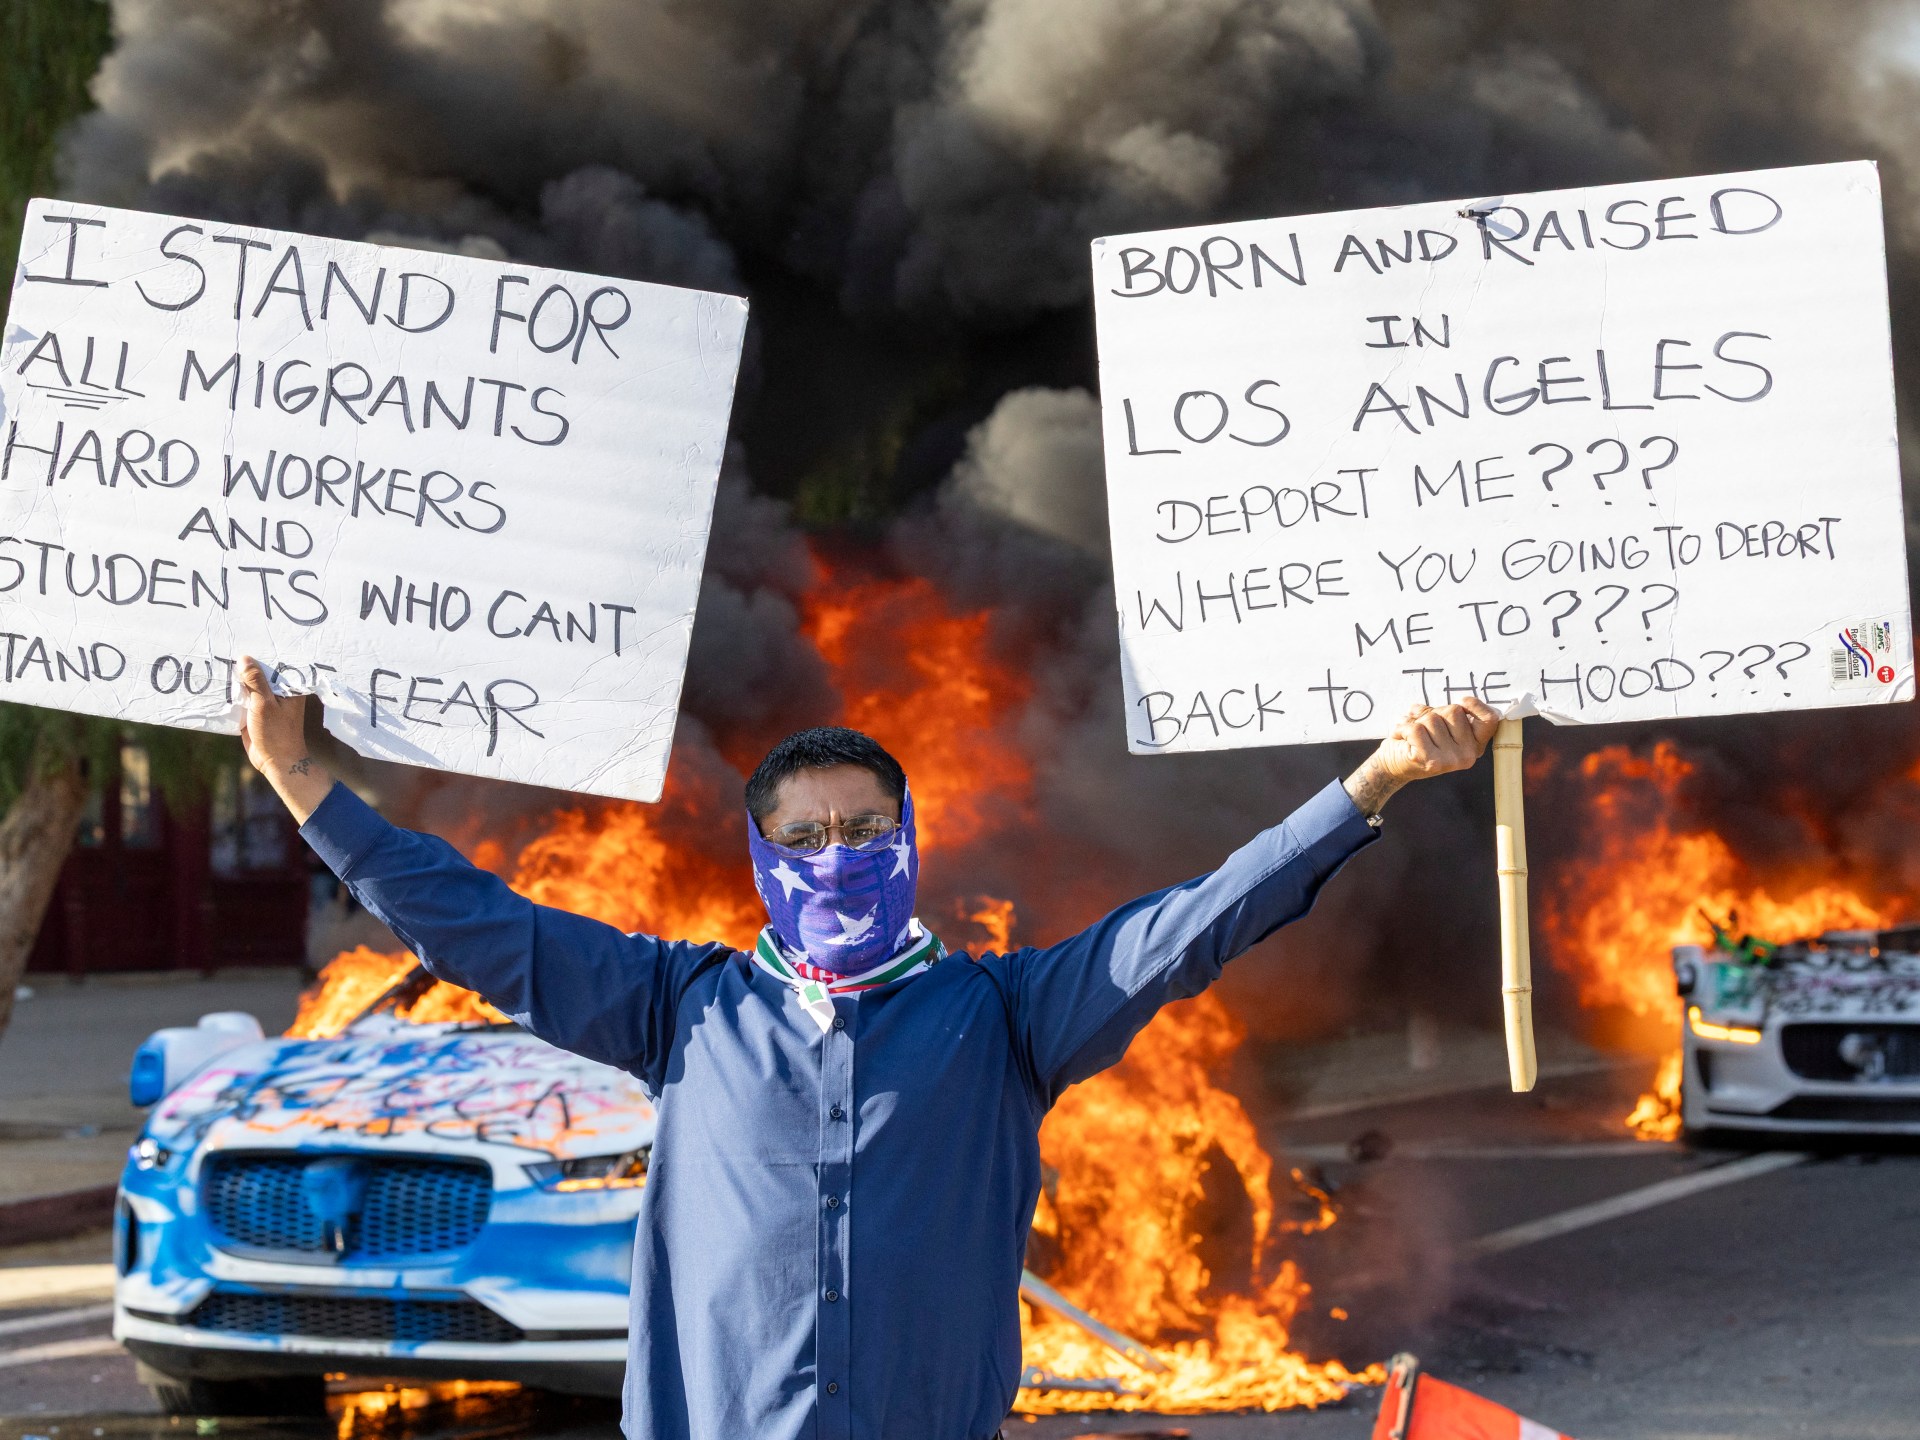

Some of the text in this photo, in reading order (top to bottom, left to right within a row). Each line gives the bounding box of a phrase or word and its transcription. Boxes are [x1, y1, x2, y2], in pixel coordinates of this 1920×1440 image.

[24, 215, 632, 364] I STAND FOR
[1111, 188, 1783, 298] BORN AND RAISED
[1365, 314, 1450, 349] IN
[17, 331, 570, 446] ALL MIGRANTS
[1123, 331, 1773, 455] LOS ANGELES
[1, 420, 507, 534] HARD WORKERS
[1156, 468, 1378, 543] DEPORT
[178, 507, 313, 559] AND
[1138, 517, 1842, 632] WHERE YOU GOING TO DEPORT
[359, 575, 471, 632] WHO
[487, 589, 636, 656] CANT
[1355, 612, 1434, 657] ME
[150, 655, 237, 703] OUT
[369, 668, 545, 757] FEAR
[1136, 683, 1285, 747] BACK
[1402, 667, 1511, 706] THE
